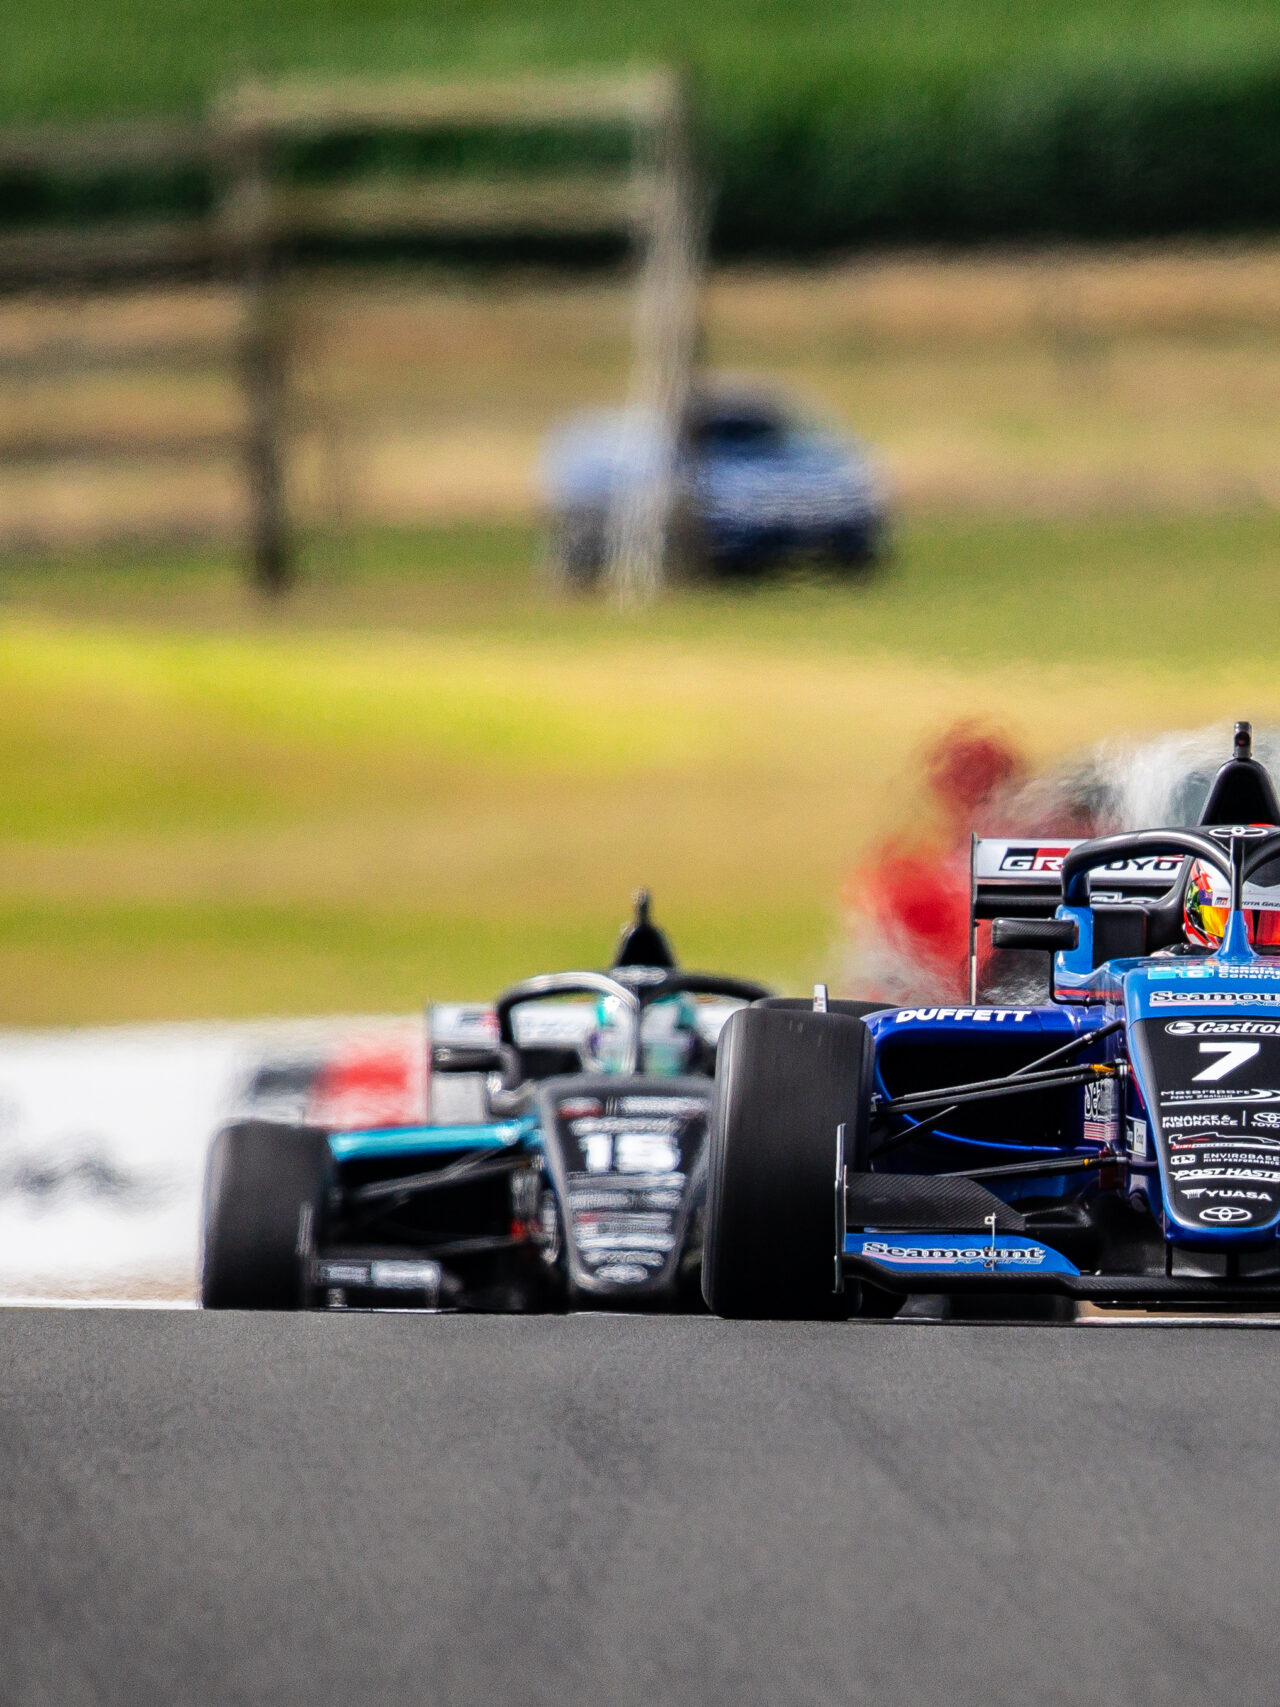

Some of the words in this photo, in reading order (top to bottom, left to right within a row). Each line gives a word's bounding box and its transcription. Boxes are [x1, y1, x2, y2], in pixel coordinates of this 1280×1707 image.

[1000, 855, 1064, 871] GR
[895, 1008, 1033, 1023] DUFFETT
[1191, 1042, 1261, 1081] 7
[1162, 1120, 1238, 1129] INSURANCE
[1203, 1153, 1280, 1161] ENVIROBASE
[1223, 1158, 1280, 1166] PERFORMANCE
[1174, 1168, 1225, 1180] POST
[1206, 1190, 1273, 1201] YUASA
[862, 1242, 1046, 1259] Seamount
